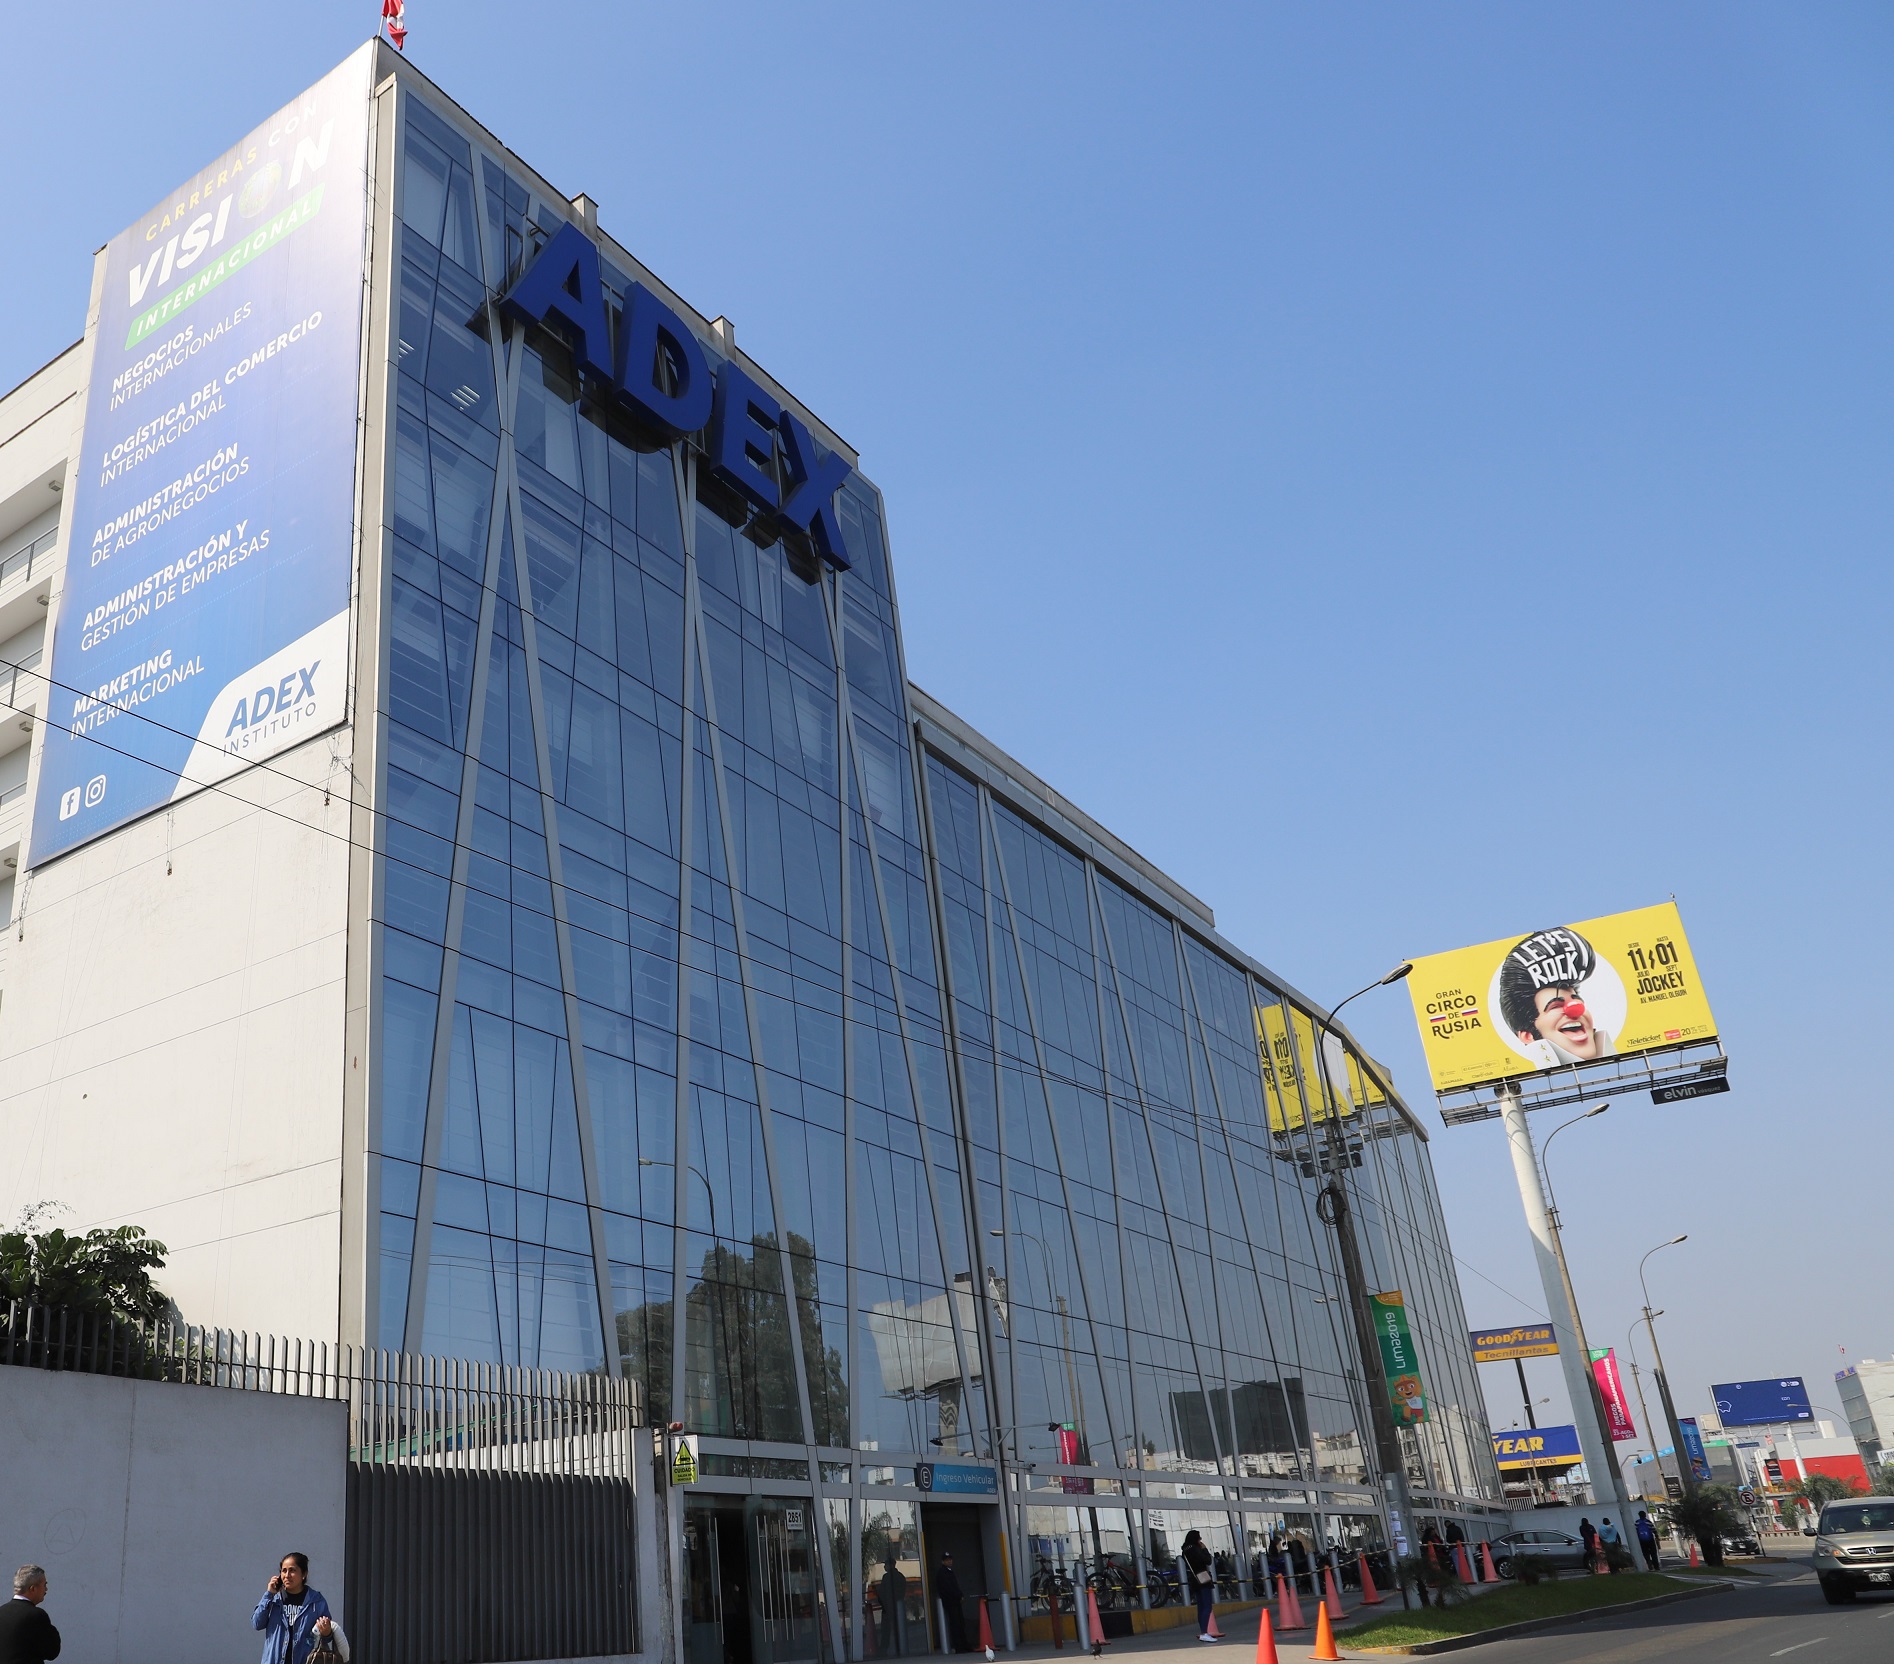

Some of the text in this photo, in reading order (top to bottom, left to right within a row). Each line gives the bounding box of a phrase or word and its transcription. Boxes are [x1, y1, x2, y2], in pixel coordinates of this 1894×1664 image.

[146, 104, 317, 241] CARRERAS CON
[136, 202, 313, 337] INTERNACIONAL
[110, 301, 252, 412] INTERNACIONALES
[112, 324, 195, 393] NEGOCIOS
[103, 311, 323, 468] LOGÍSTICA DEL COMERCIO
[500, 220, 853, 573] ADEX
[100, 395, 227, 488] INTERNACIONAL
[90, 456, 250, 568] DE AGRONEGOCIOS
[92, 443, 239, 547] ADMINISTRACIÓN
[80, 529, 271, 652] GESTIÓN DE EMPRESAS
[82, 519, 249, 631] ADMINISTRACIÓN Y
[70, 655, 205, 742] INTERNACIONAL
[72, 648, 173, 719] MARKETING
[225, 659, 322, 739] ADEX
[222, 702, 317, 758] INSTITUTO
[1512, 930, 1576, 967] LET'S
[1627, 947, 1647, 971] 11
[1655, 941, 1679, 966] 01
[1637, 970, 1650, 978] JULIO
[1637, 971, 1685, 995] JOCKEY
[1666, 964, 1678, 972] SEPT
[1426, 995, 1477, 1014] CIRCO
[1435, 988, 1462, 999] GRAN
[1648, 992, 1668, 1003] MANUEL
[1431, 1017, 1482, 1039] RUSIA
[1664, 1085, 1697, 1100] elvin
[1477, 1329, 1550, 1346] GOODYEAR
[1484, 1347, 1549, 1359] Tecnillantas
[674, 1466, 696, 1474] CUIDADO
[936, 1472, 994, 1485] Ingreso Vehicular
[788, 1511, 802, 1523] 2851
